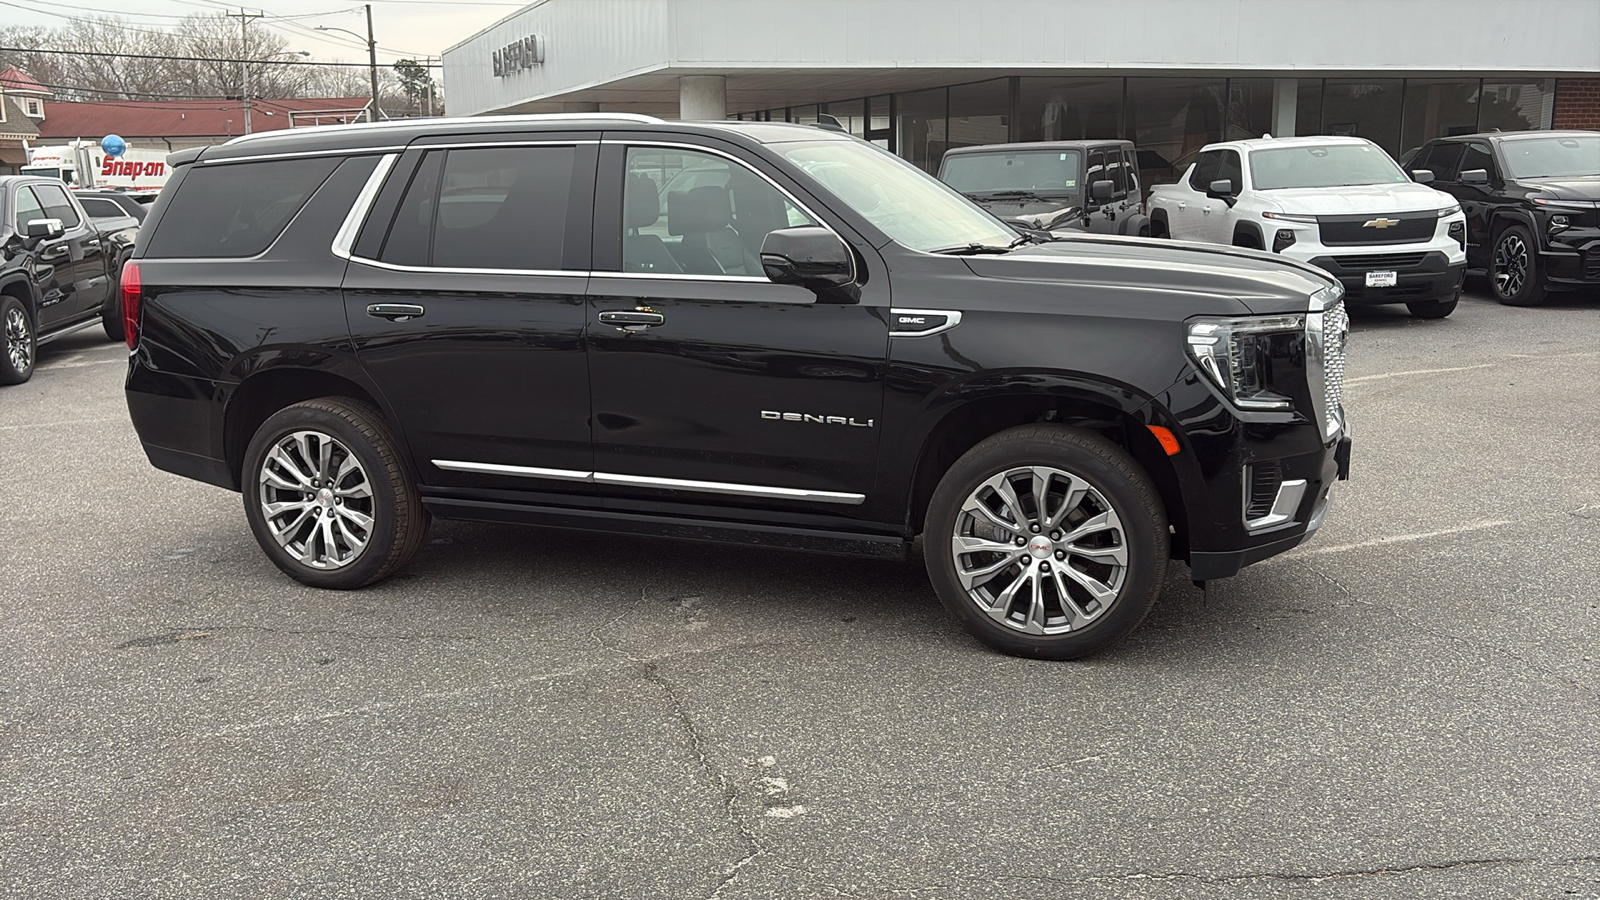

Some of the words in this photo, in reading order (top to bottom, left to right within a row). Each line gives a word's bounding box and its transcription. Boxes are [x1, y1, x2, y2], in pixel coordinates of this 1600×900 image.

[101, 154, 164, 181] Snap-on
[899, 316, 925, 324] GMC
[760, 410, 874, 428] DENALI
